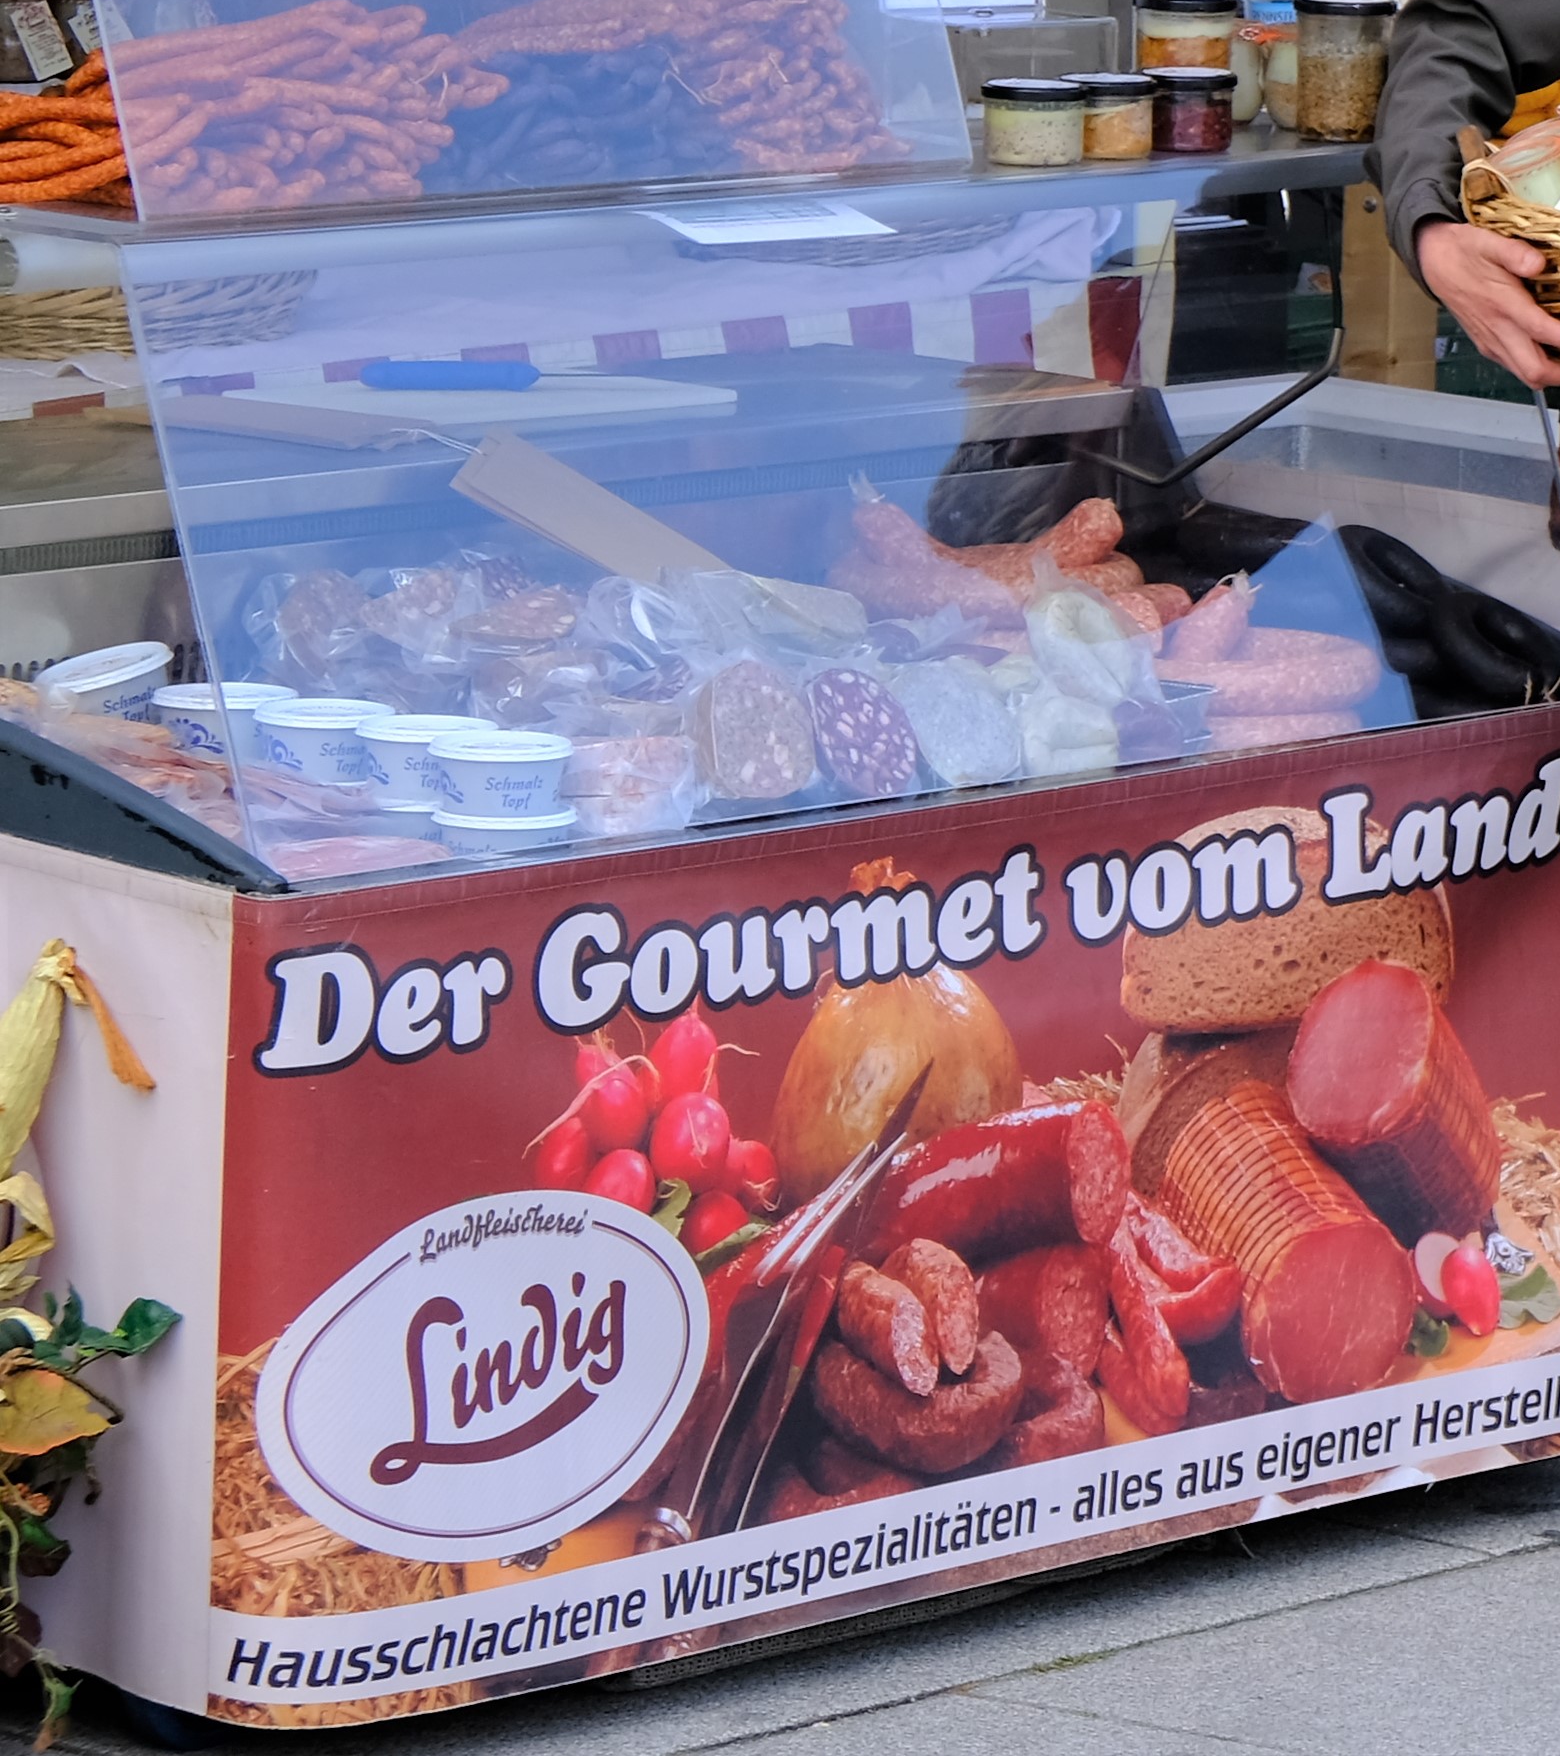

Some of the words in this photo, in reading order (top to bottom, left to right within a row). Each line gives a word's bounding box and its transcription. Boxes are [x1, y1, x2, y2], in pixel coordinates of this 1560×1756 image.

[420, 773, 443, 791] Top
[485, 775, 544, 792] Schmalz
[501, 793, 532, 810] Topf
[259, 947, 508, 1073] Der
[536, 848, 1046, 1029] Gourmet
[1065, 824, 1300, 942] vom
[419, 1206, 591, 1265] Landfleischerei
[369, 1271, 629, 1487] Lindig
[225, 1587, 646, 1693] Hausschlachtene
[661, 1496, 1038, 1622] Wurstspezialitäten
[1071, 1463, 1164, 1522] alles
[1175, 1448, 1245, 1500] aus
[1254, 1414, 1403, 1482] eigener
